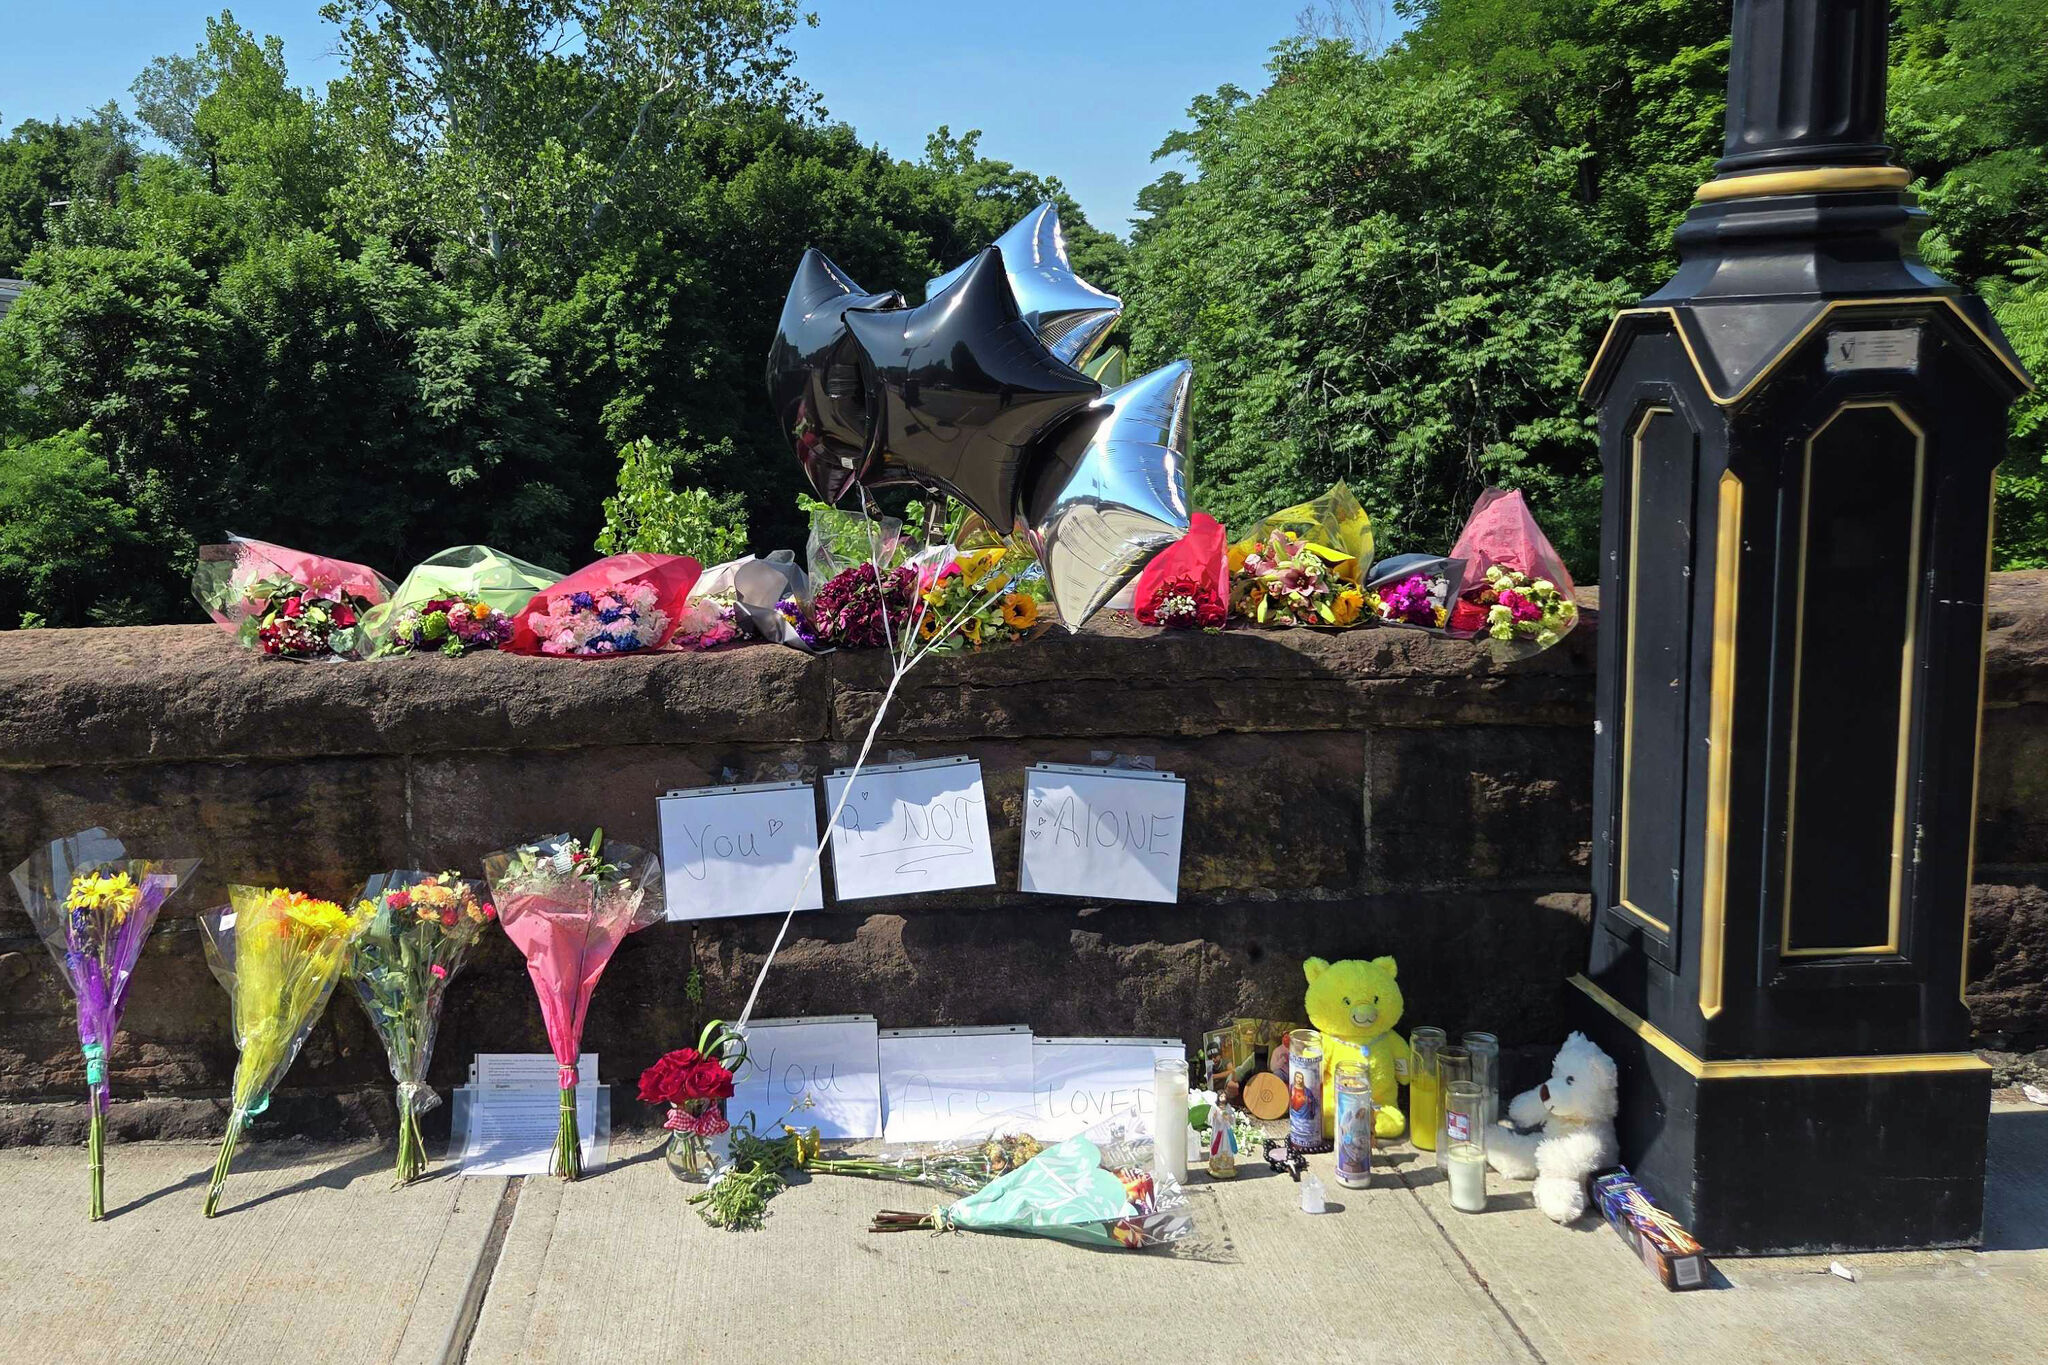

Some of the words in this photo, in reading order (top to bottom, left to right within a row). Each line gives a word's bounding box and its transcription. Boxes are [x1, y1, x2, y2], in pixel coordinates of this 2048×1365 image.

[840, 803, 864, 844] R
[903, 796, 984, 844] NOT
[749, 1047, 843, 1106] You
[902, 1073, 996, 1123] Are
[1048, 1081, 1154, 1119] LOVED
